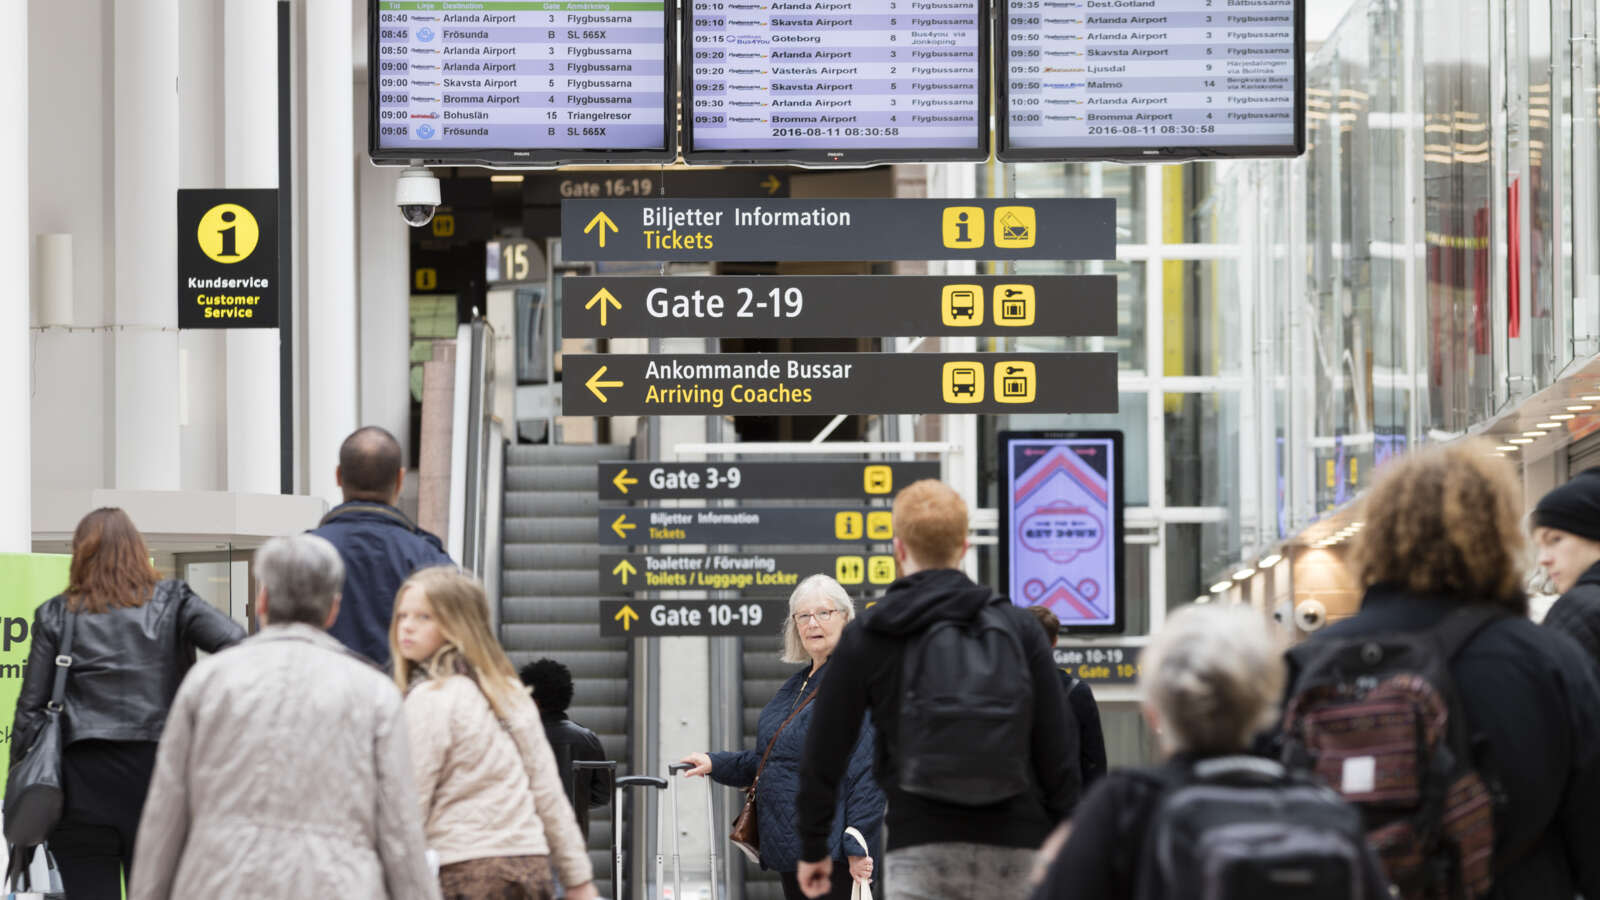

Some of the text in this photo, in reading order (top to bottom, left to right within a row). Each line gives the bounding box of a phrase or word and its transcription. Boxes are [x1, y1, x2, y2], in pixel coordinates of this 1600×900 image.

[815, 2, 852, 11] Airport
[1011, 1, 1039, 9] 09:35
[382, 14, 407, 23] 08:40
[443, 14, 480, 23] Arlanda
[482, 14, 516, 24] Airport
[549, 14, 554, 23] 3
[568, 14, 632, 24] Flygbussarna
[816, 18, 852, 28] Airport
[1131, 16, 1168, 25] Airport
[382, 30, 606, 40] 08:45 Frösunda B SL 565X
[1131, 32, 1168, 41] Airport
[382, 46, 407, 55] 08:50
[443, 46, 480, 55] Arlanda
[482, 46, 516, 56] Airport
[549, 46, 554, 55] 3
[568, 46, 632, 56] Flygbussarna
[815, 51, 852, 60] Airport
[1011, 49, 1039, 57] 09:50
[1132, 48, 1168, 57] Airport
[382, 63, 407, 71] 09:00
[443, 63, 480, 71] Arlanda
[482, 63, 516, 72] Airport
[549, 63, 554, 71] 3
[568, 63, 632, 72] Flygbussarna
[822, 67, 858, 76] Airport
[1011, 66, 1039, 74] 09:50
[1087, 64, 1125, 74] Ljusdal
[382, 79, 407, 87] 09:00
[443, 79, 482, 87] Skavsta
[484, 79, 517, 89] Airport
[549, 79, 554, 87] 5
[568, 79, 632, 89] Flygbussarna
[816, 83, 852, 92] Airport
[1011, 82, 1039, 90] 09:50
[382, 95, 407, 103] 09:00
[443, 95, 485, 103] Bromma
[487, 95, 520, 105] Airport
[549, 95, 554, 103] 4
[568, 95, 632, 105] Flygbussarna
[815, 99, 852, 108] Airport
[1011, 98, 1039, 106] 10:00
[1131, 96, 1168, 106] Airport
[382, 111, 407, 119] 09:00
[443, 111, 489, 119] Bohuslän
[547, 111, 557, 119] 15
[568, 111, 632, 121] Triangelresor
[821, 115, 857, 124] Airport
[1011, 114, 1039, 122] 10:00
[1136, 112, 1172, 122] Airport
[382, 127, 606, 136] 09:05 Frösunda B SL 565X
[772, 128, 899, 136] 2016-08-11 08:30:58
[1088, 125, 1215, 134] 2016-08-11 08:30:58
[560, 179, 652, 197] Gate 16-19
[643, 207, 850, 231] Biljetter Information
[643, 230, 713, 249] Tickets
[503, 244, 529, 280] 15
[188, 277, 269, 289] Kundservice
[197, 294, 260, 306] Customer
[646, 287, 803, 318] Gate 2-19
[204, 307, 253, 318] Service
[645, 360, 852, 379] Ankommande Bussar
[645, 384, 812, 408] Arriving Coaches
[650, 468, 741, 489] Gate 3-9
[651, 513, 759, 526] Biljetter Information
[649, 528, 686, 540] Tickets
[646, 557, 703, 570] Toaletter
[713, 555, 775, 572] Förvaring
[645, 573, 686, 585] Toilets
[698, 572, 752, 588] Luggage
[755, 571, 799, 585] Locker
[650, 605, 762, 627] Gate 10-19
[1053, 649, 1123, 663] Gate 10-19
[1078, 665, 1110, 678] Gate
